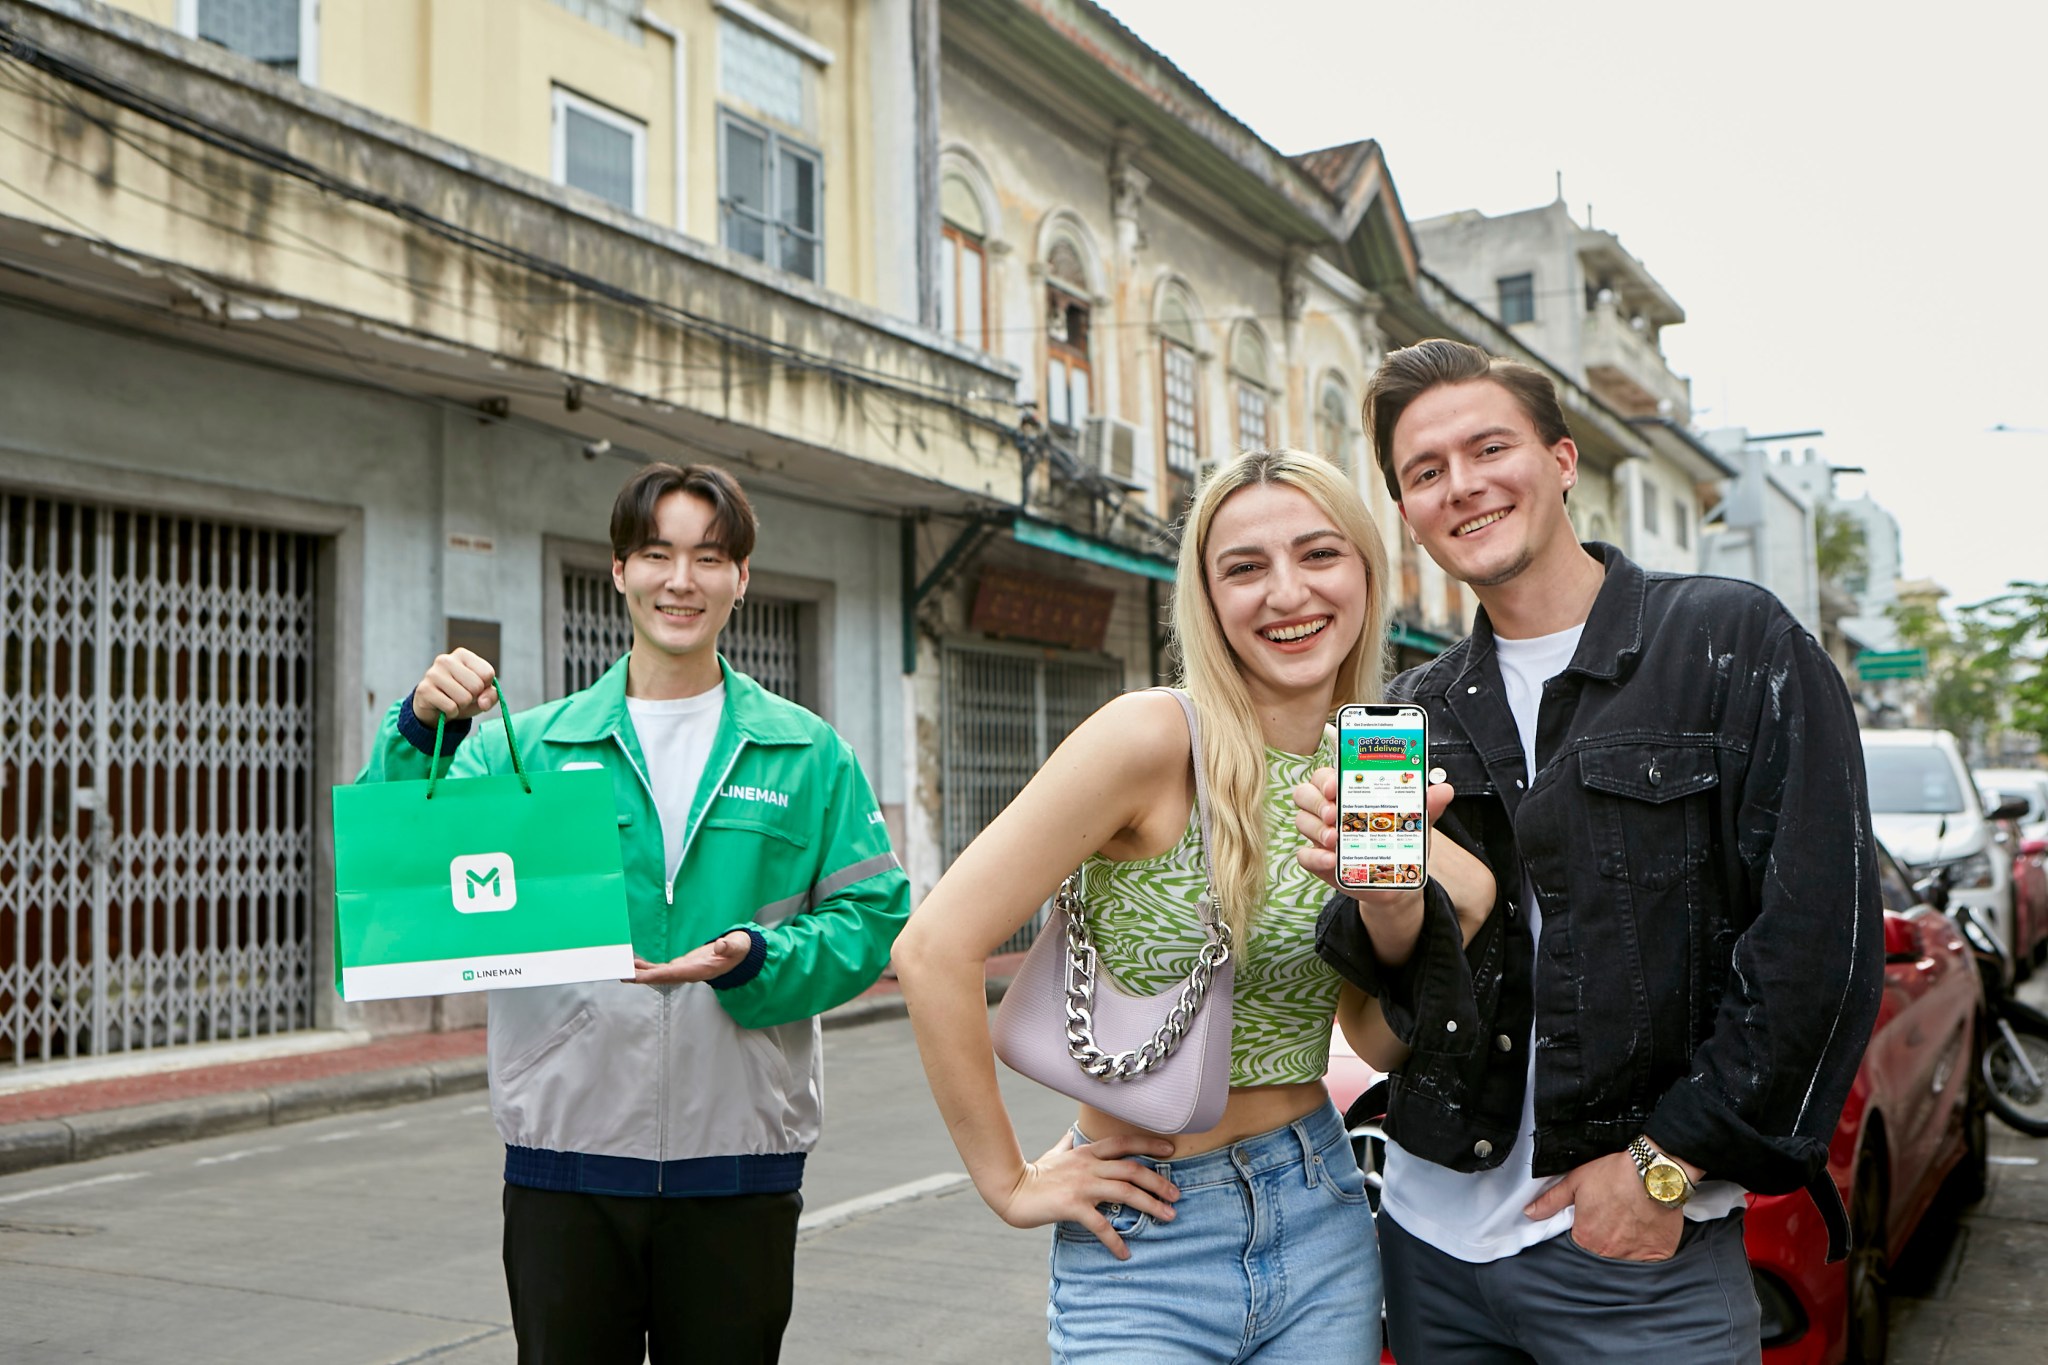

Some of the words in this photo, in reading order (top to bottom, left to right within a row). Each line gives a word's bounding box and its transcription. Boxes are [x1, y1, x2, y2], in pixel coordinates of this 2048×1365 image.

[1381, 737, 1406, 745] orders
[1373, 745, 1405, 754] delivery
[719, 785, 789, 808] LINEMAN
